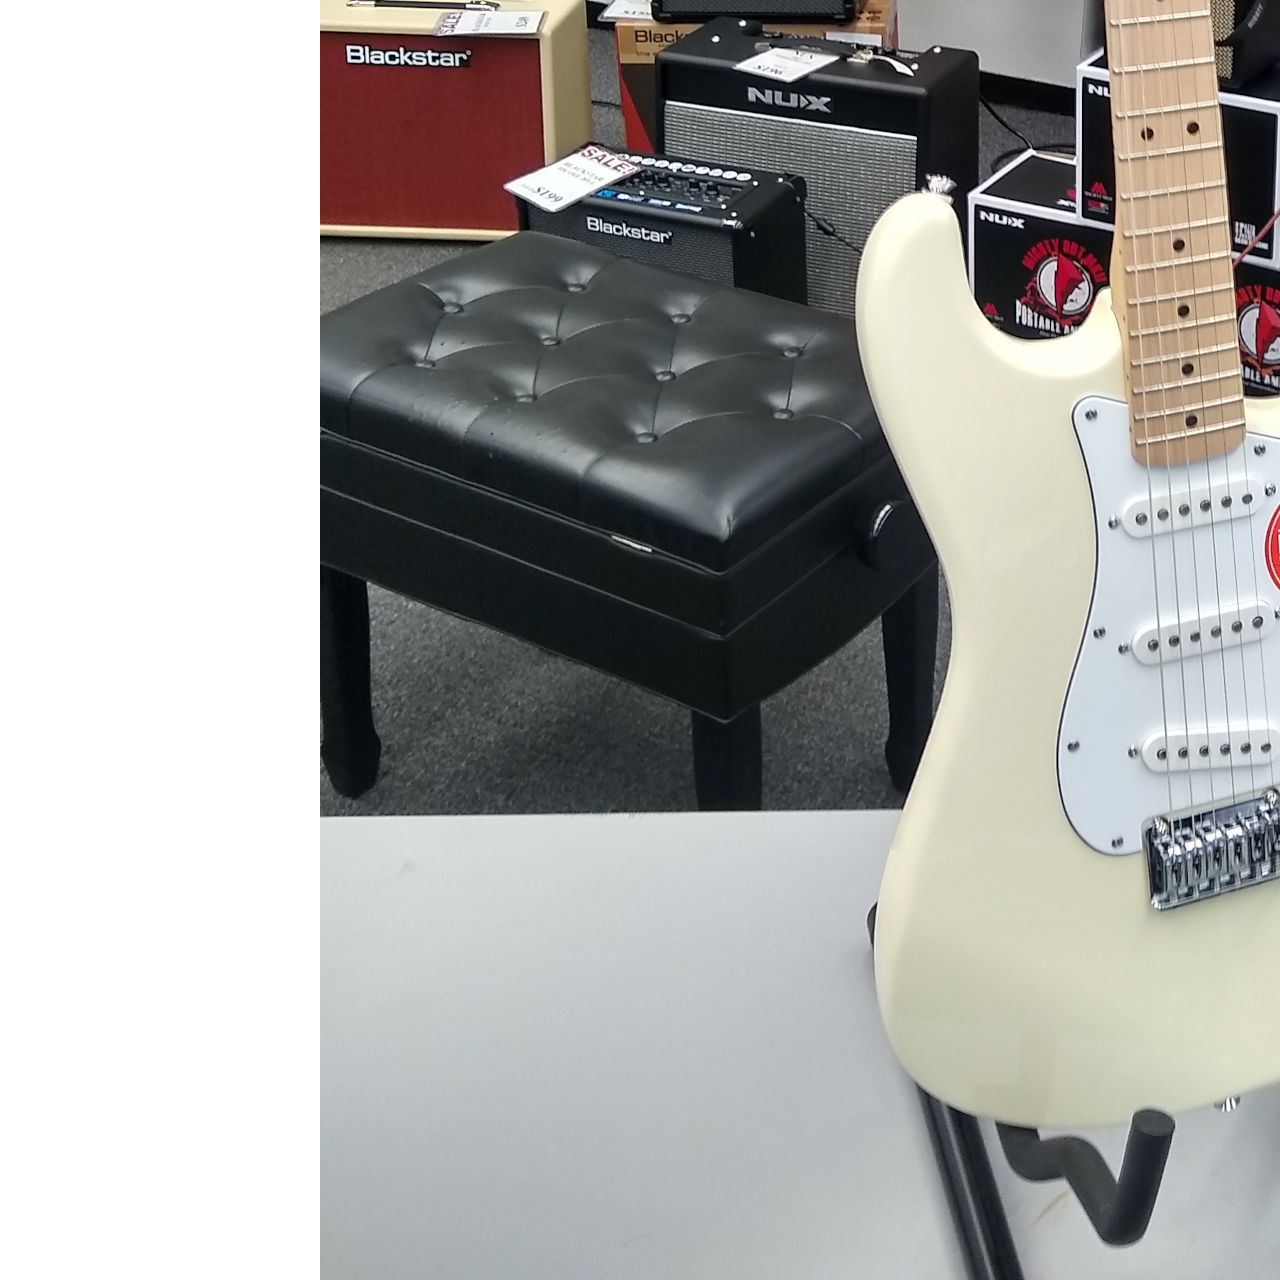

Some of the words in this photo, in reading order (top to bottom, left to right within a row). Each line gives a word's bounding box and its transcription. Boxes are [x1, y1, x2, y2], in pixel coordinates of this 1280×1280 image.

[634, 29, 686, 45] Black
[345, 44, 468, 68] Blackstar
[747, 86, 832, 114] NUX
[580, 147, 637, 175] SALE!
[586, 216, 671, 244] Blackstar
[979, 210, 1025, 230] NUX
[1015, 298, 1062, 334] PORTABLE
